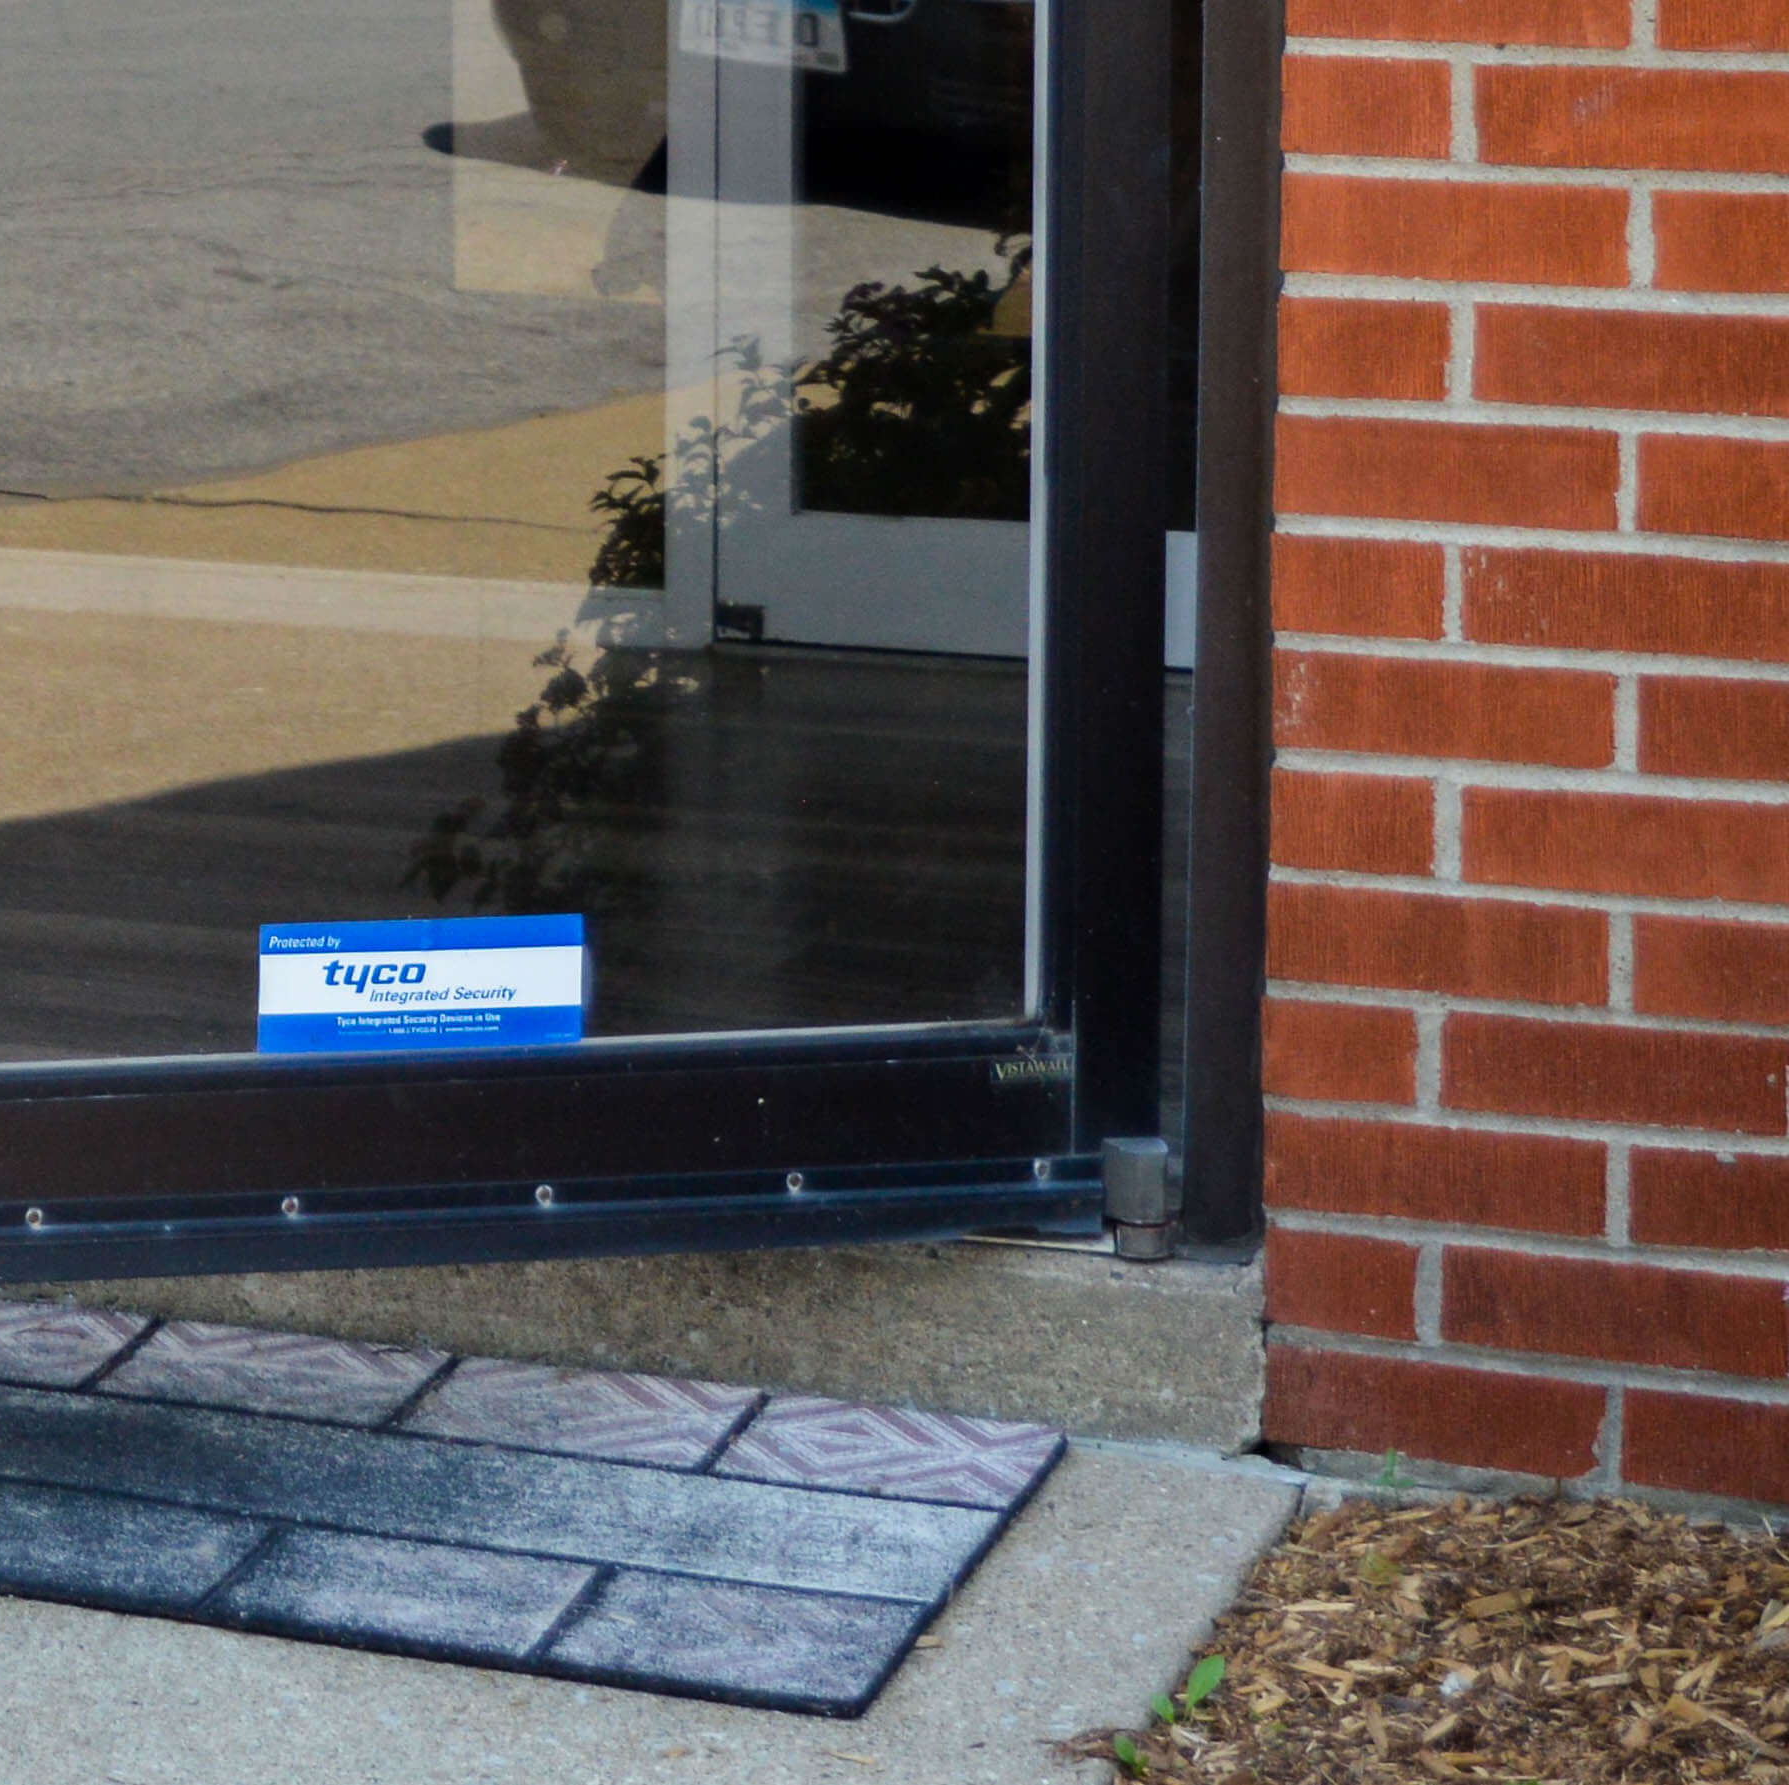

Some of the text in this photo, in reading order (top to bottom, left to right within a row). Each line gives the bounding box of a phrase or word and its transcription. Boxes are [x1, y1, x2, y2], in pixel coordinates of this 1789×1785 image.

[268, 934, 341, 950] Protected by
[322, 959, 427, 994] tyco
[369, 985, 517, 1004] Integrated Security
